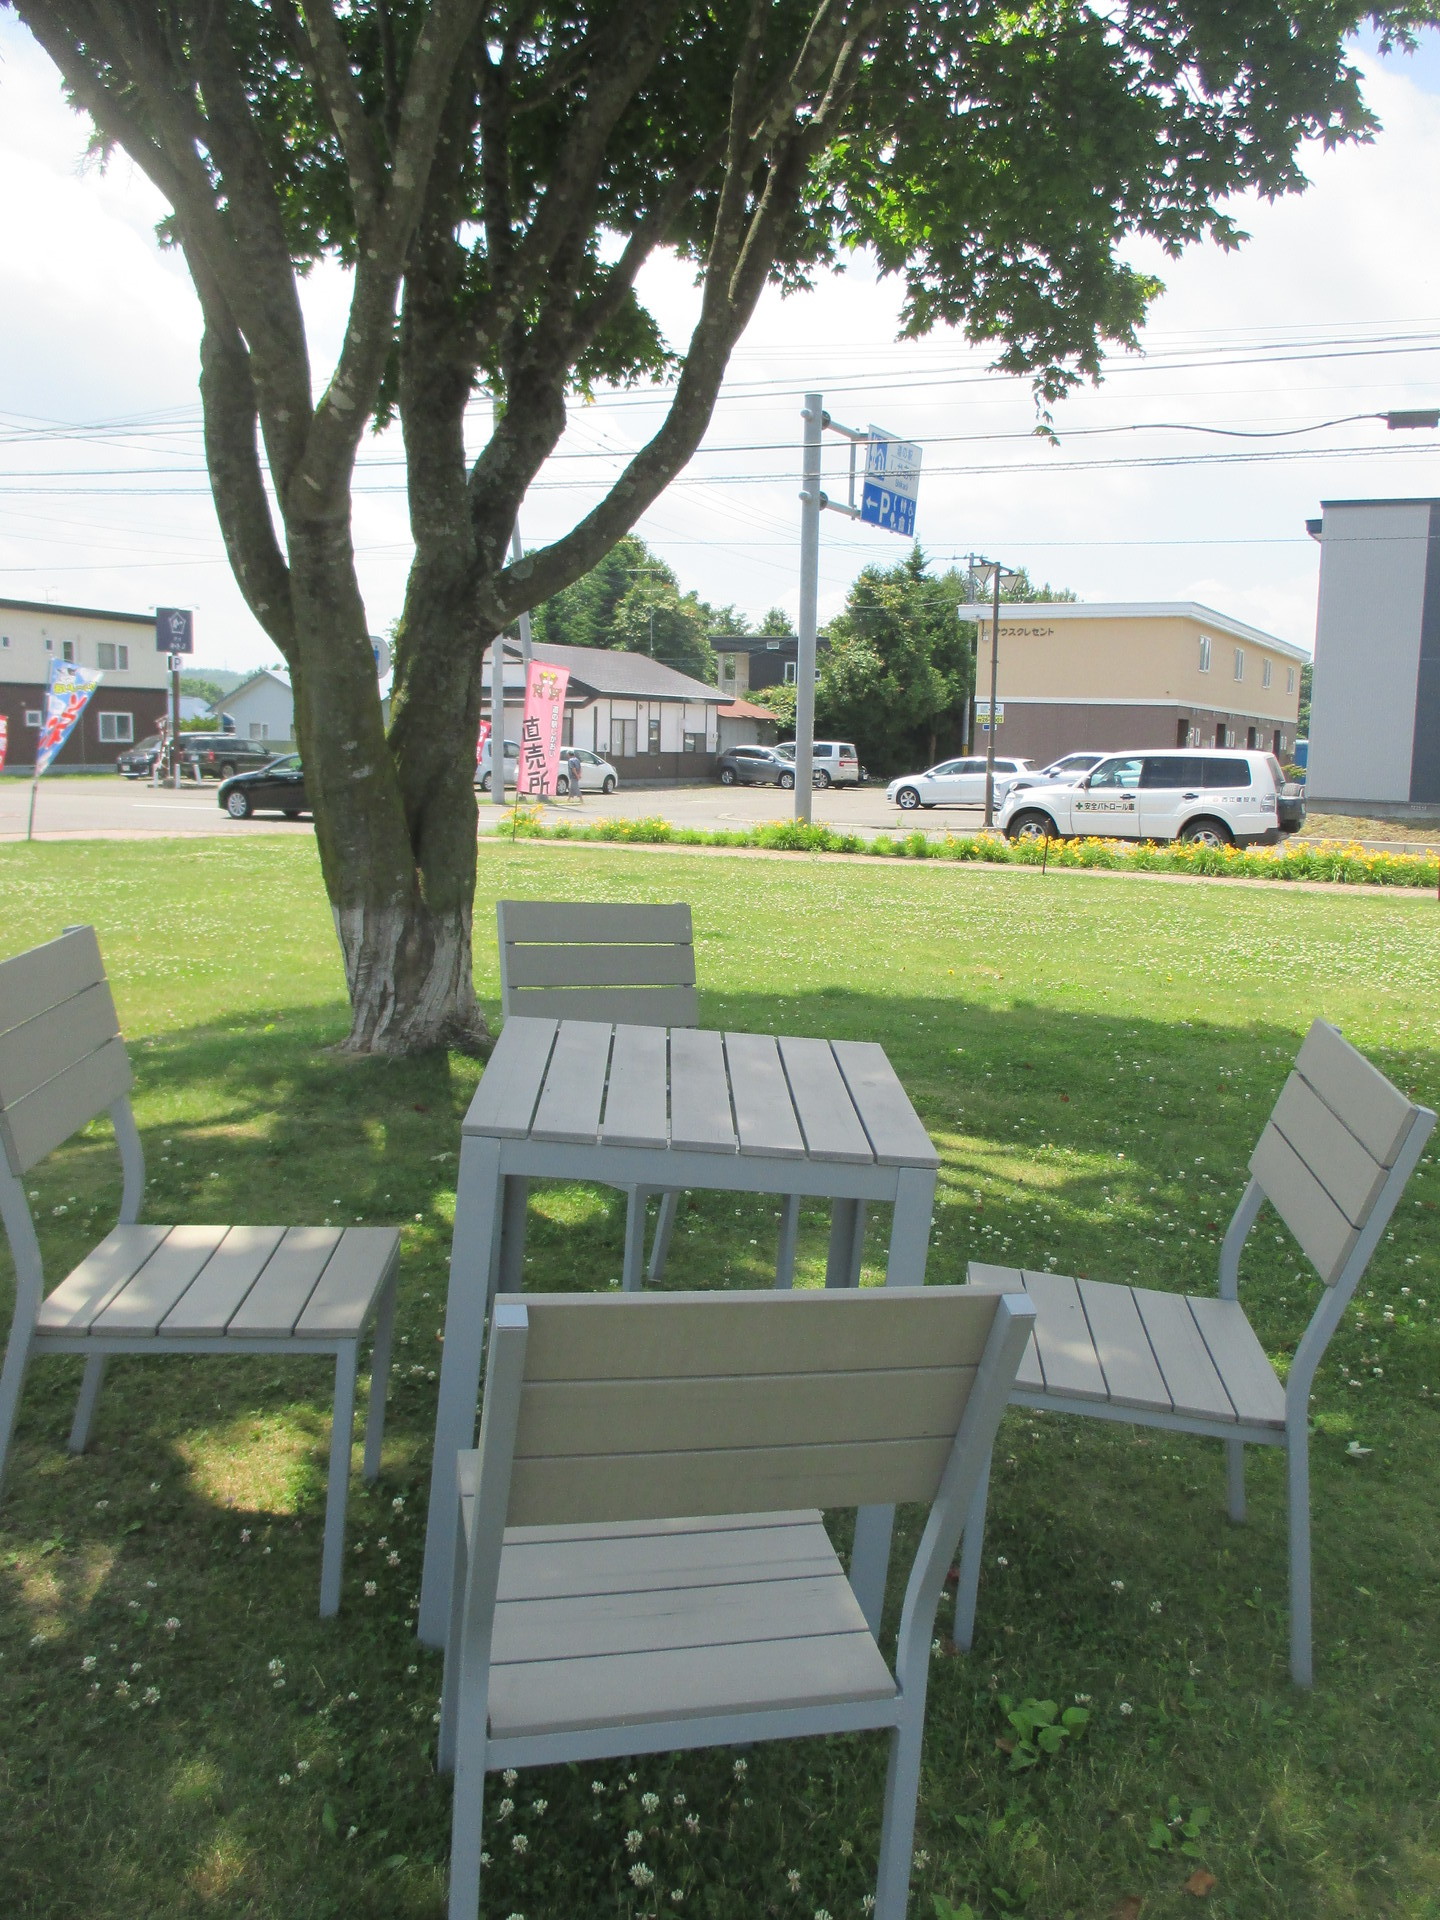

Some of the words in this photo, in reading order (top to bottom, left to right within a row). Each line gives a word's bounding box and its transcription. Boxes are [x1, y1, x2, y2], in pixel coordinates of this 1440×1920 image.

[878, 491, 891, 523] P
[998, 627, 1054, 637] ウスクレセント
[174, 657, 181, 670] P
[522, 716, 551, 795] 直売所
[1084, 802, 1135, 812] 安全パトロール車
